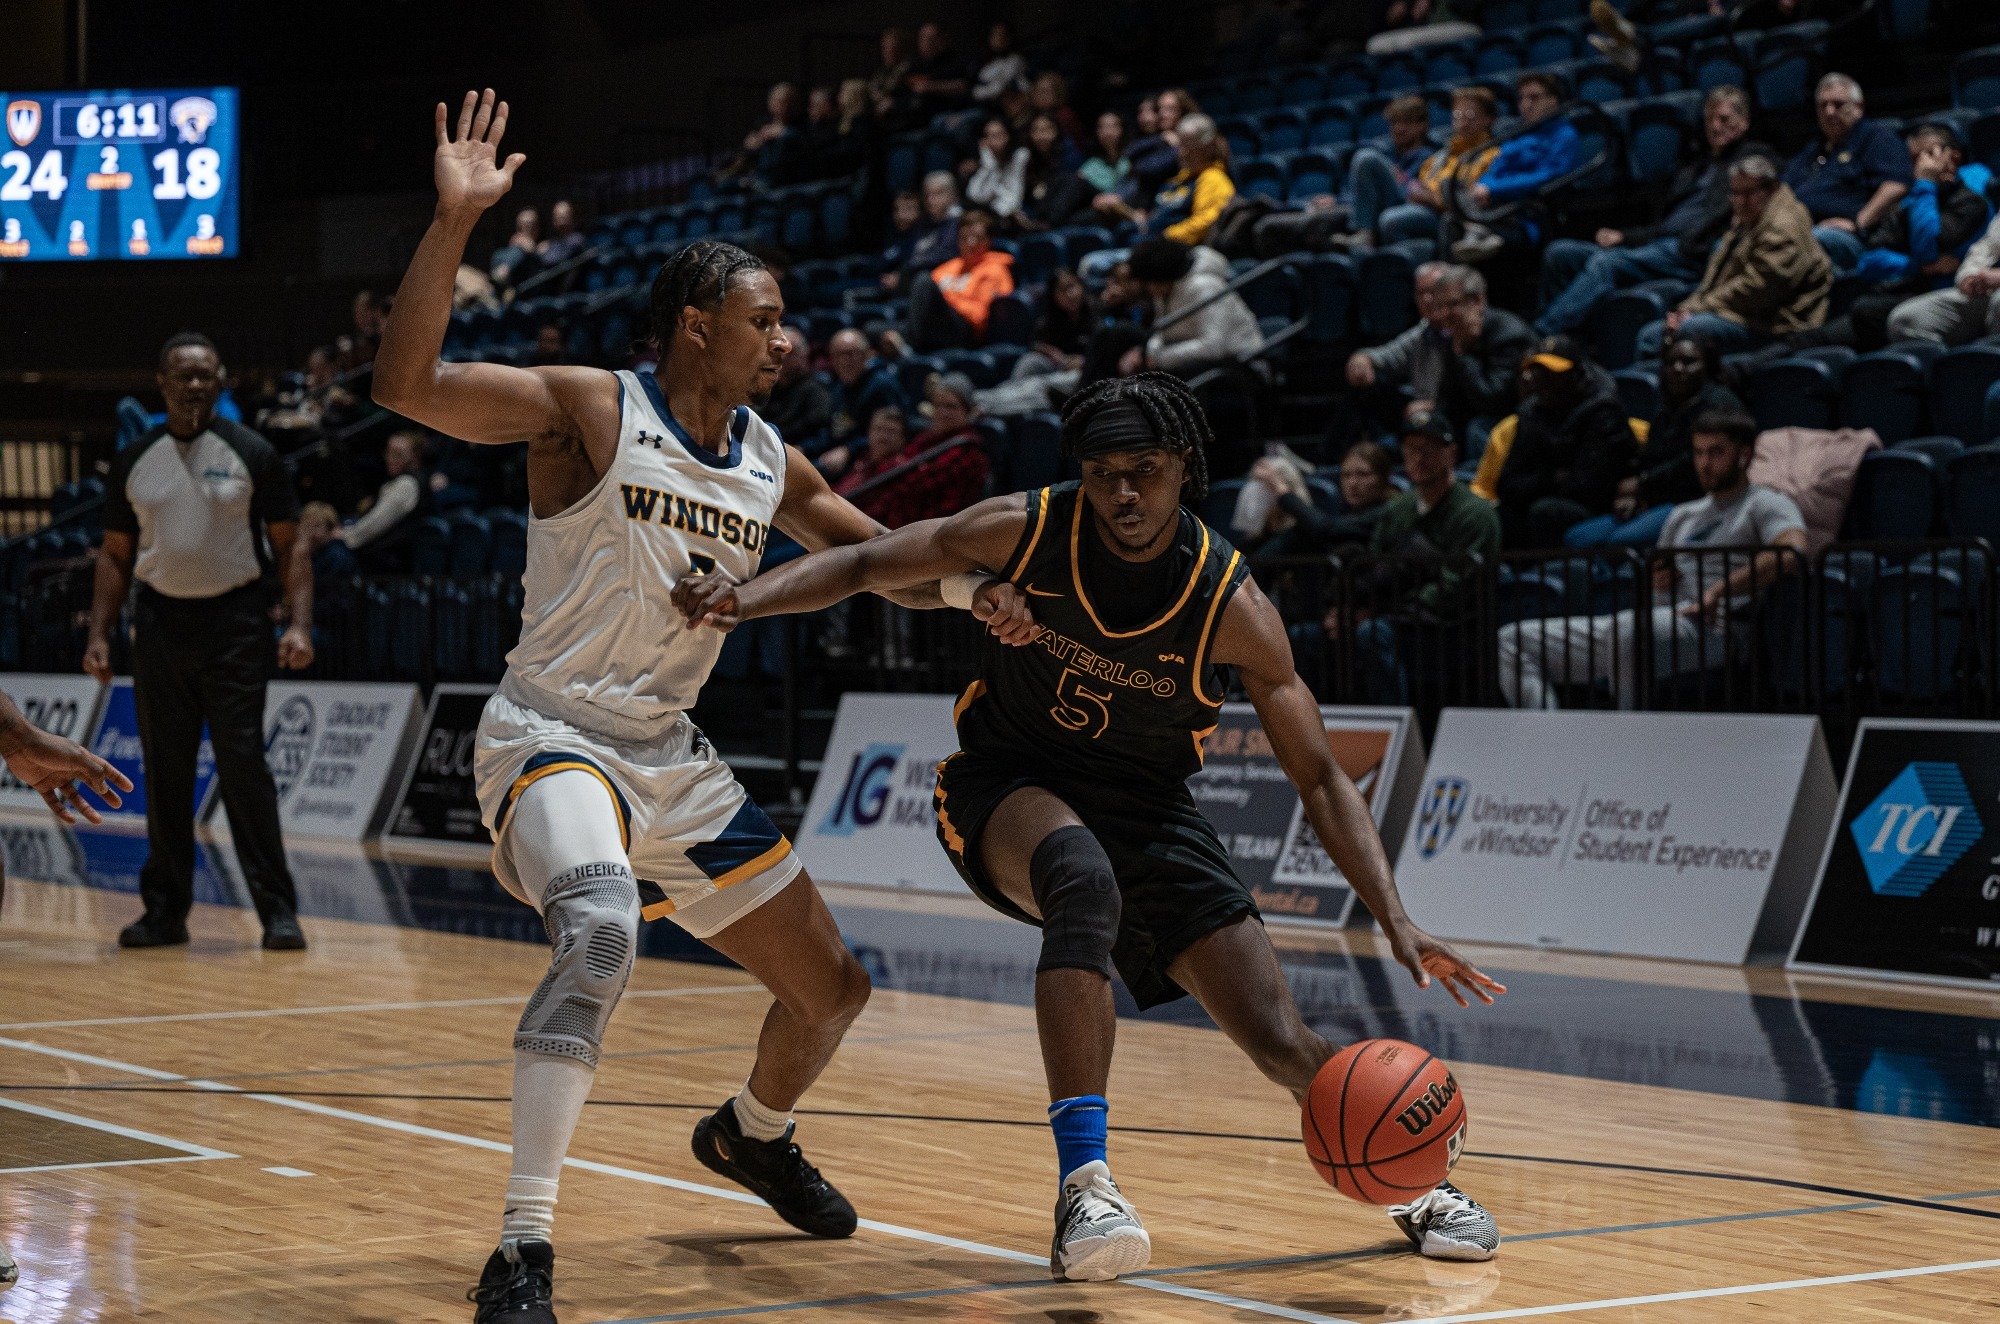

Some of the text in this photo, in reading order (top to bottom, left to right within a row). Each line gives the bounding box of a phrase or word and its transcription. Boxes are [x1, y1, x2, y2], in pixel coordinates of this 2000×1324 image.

[77, 103, 160, 138] 6:11
[0, 150, 68, 200] 24
[100, 146, 119, 174] 2
[153, 147, 221, 199] 18
[5, 218, 21, 243] 3
[196, 213, 215, 240] 3
[1034, 624, 1176, 698] ATERLOO
[1050, 667, 1112, 740] 5
[834, 752, 895, 826] IG
[1471, 796, 1569, 834] University
[1584, 799, 1670, 833] Office of
[1867, 803, 1964, 857] TCI
[1477, 826, 1559, 860] Windsor
[1574, 831, 1773, 873] Student Experience
